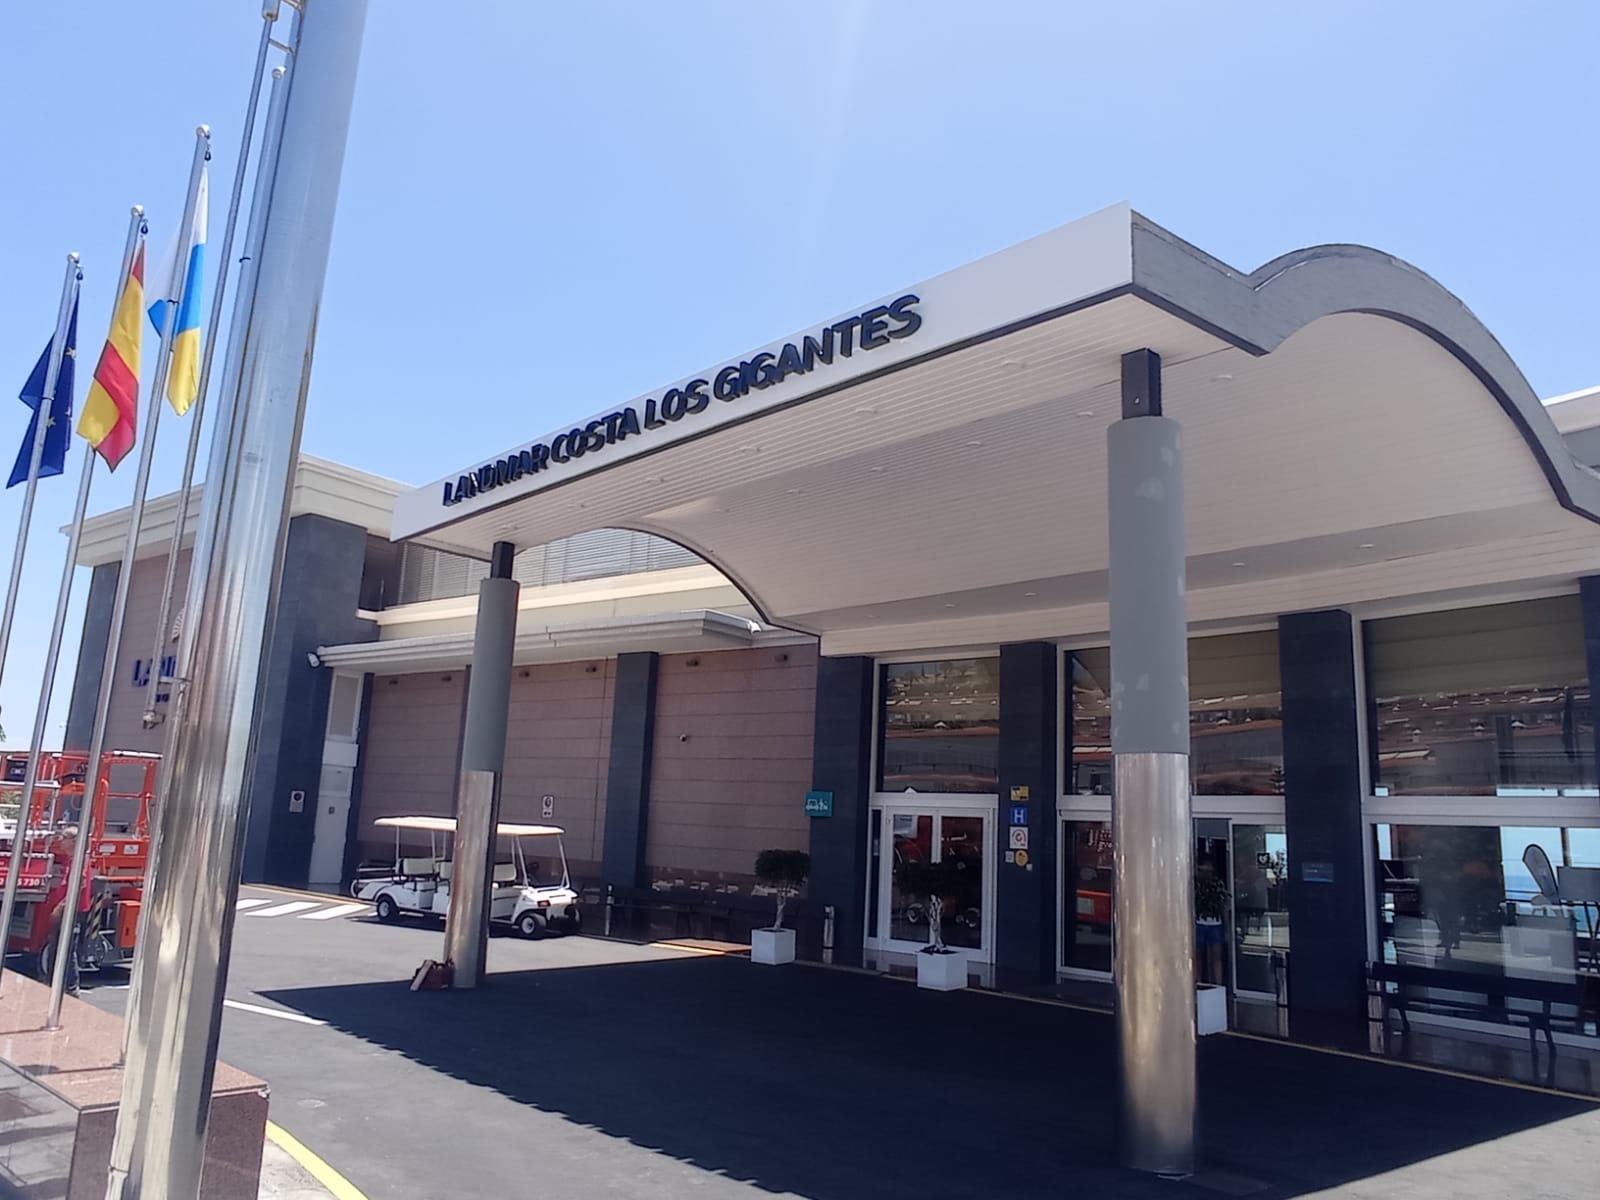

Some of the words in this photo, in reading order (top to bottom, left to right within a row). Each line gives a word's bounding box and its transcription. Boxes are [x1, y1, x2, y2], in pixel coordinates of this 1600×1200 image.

[442, 442, 549, 506] LANDMAR
[551, 408, 641, 464] COSTA
[644, 378, 709, 430] LOS
[713, 294, 922, 401] GIGANTES
